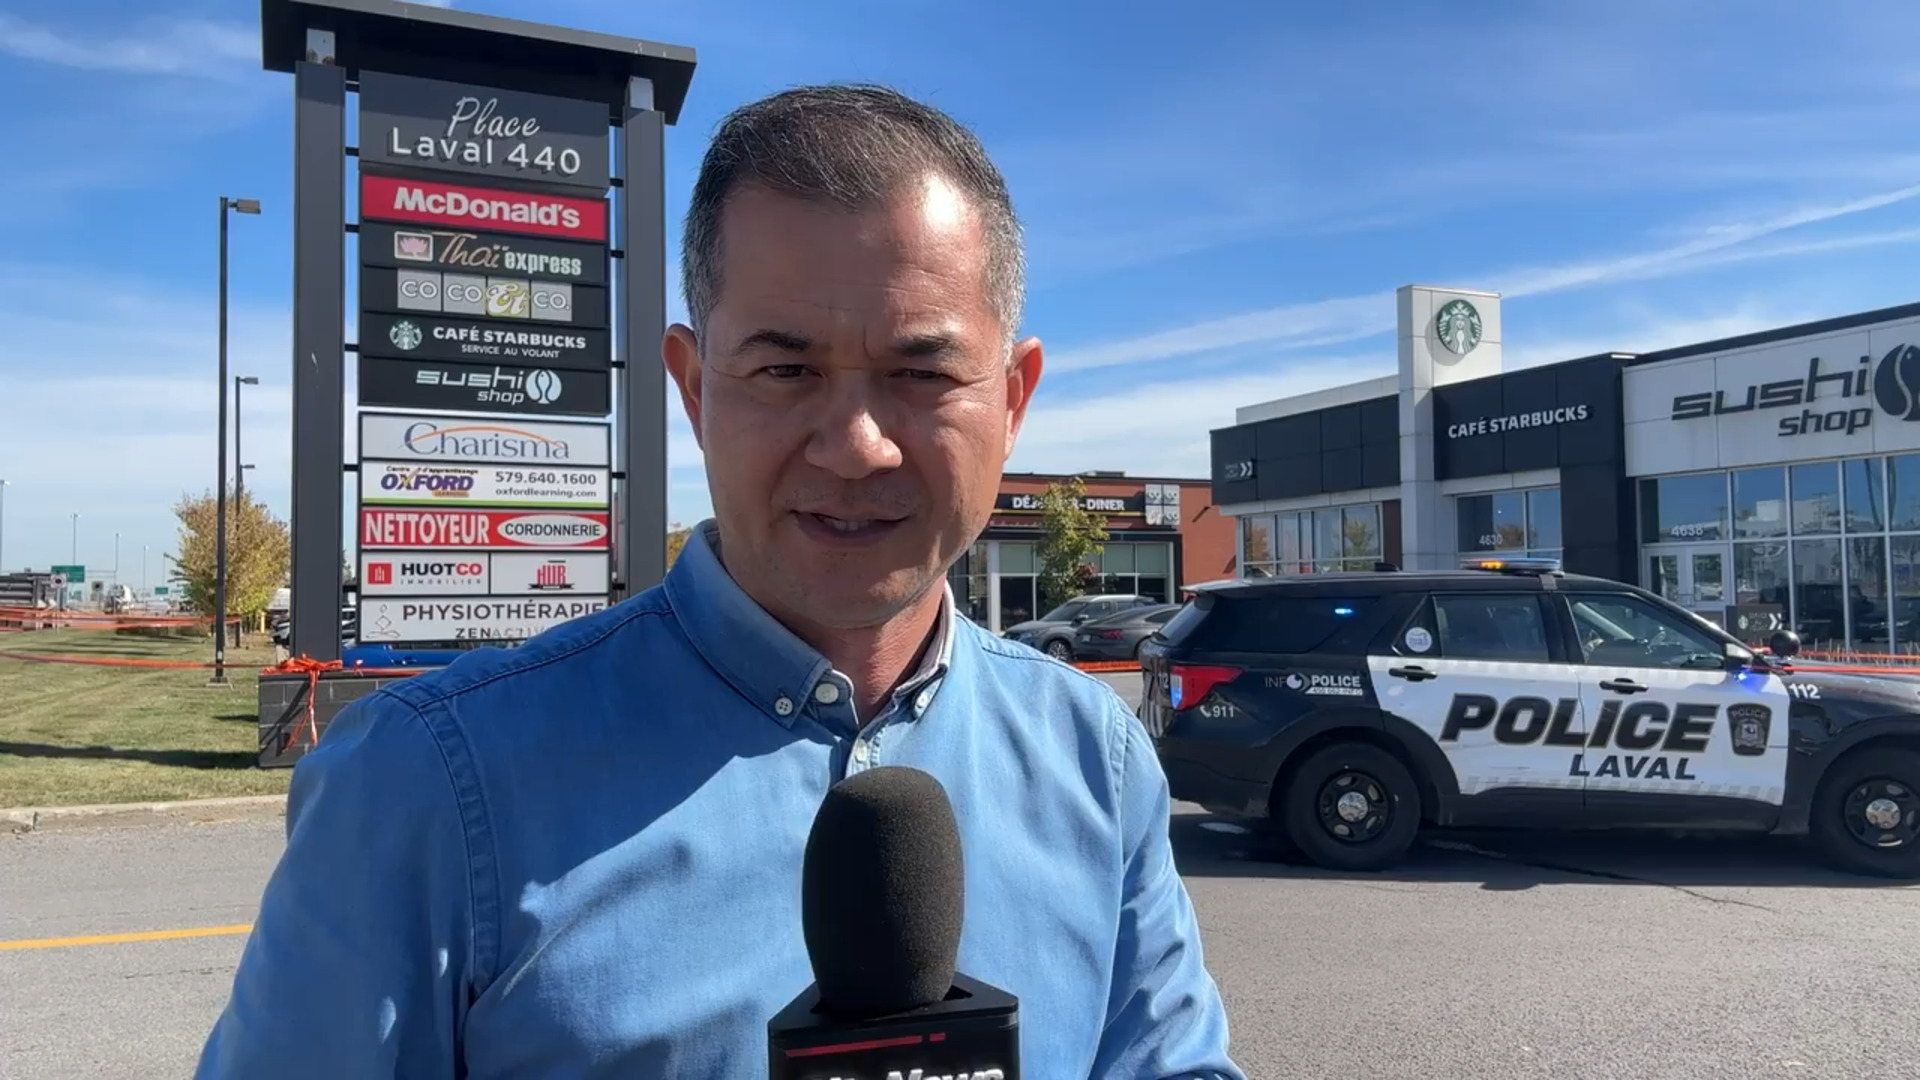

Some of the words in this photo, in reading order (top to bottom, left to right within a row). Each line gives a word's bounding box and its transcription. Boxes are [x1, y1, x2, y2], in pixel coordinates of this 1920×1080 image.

[447, 97, 540, 137] Place
[392, 127, 493, 164] Laval
[508, 143, 581, 174] 440
[394, 187, 580, 229] McDonald's
[430, 231, 510, 268] Thaï
[504, 250, 582, 276] express
[433, 326, 480, 342] CAFÉ
[483, 328, 587, 349] STARBUCKS
[461, 344, 500, 355] SERVICE
[504, 347, 518, 356] AU
[522, 348, 560, 358] VOLANT
[416, 367, 524, 390] sushi
[1671, 356, 1870, 420] sushi
[477, 389, 525, 405] shop
[1448, 417, 1487, 438] CAFÉ
[1489, 405, 1587, 432] STARBUCKS
[1778, 407, 1872, 437] shop
[403, 422, 570, 459] Charisma
[381, 473, 474, 491] OXFORD
[495, 471, 597, 485] 579.640.1600
[495, 487, 597, 498] oxfordlearning.com
[365, 513, 489, 544] NETTOYEUR
[504, 523, 601, 536] CORDONNERIE
[401, 563, 482, 576] HUOTCO
[403, 599, 605, 620] PHYSIOTHÉRAPIE
[1311, 675, 1361, 687] POLICE
[1789, 683, 1821, 699] 112
[1212, 705, 1234, 717] 911
[1439, 693, 1720, 752] POLICE
[1569, 754, 1696, 780] LAVAL
